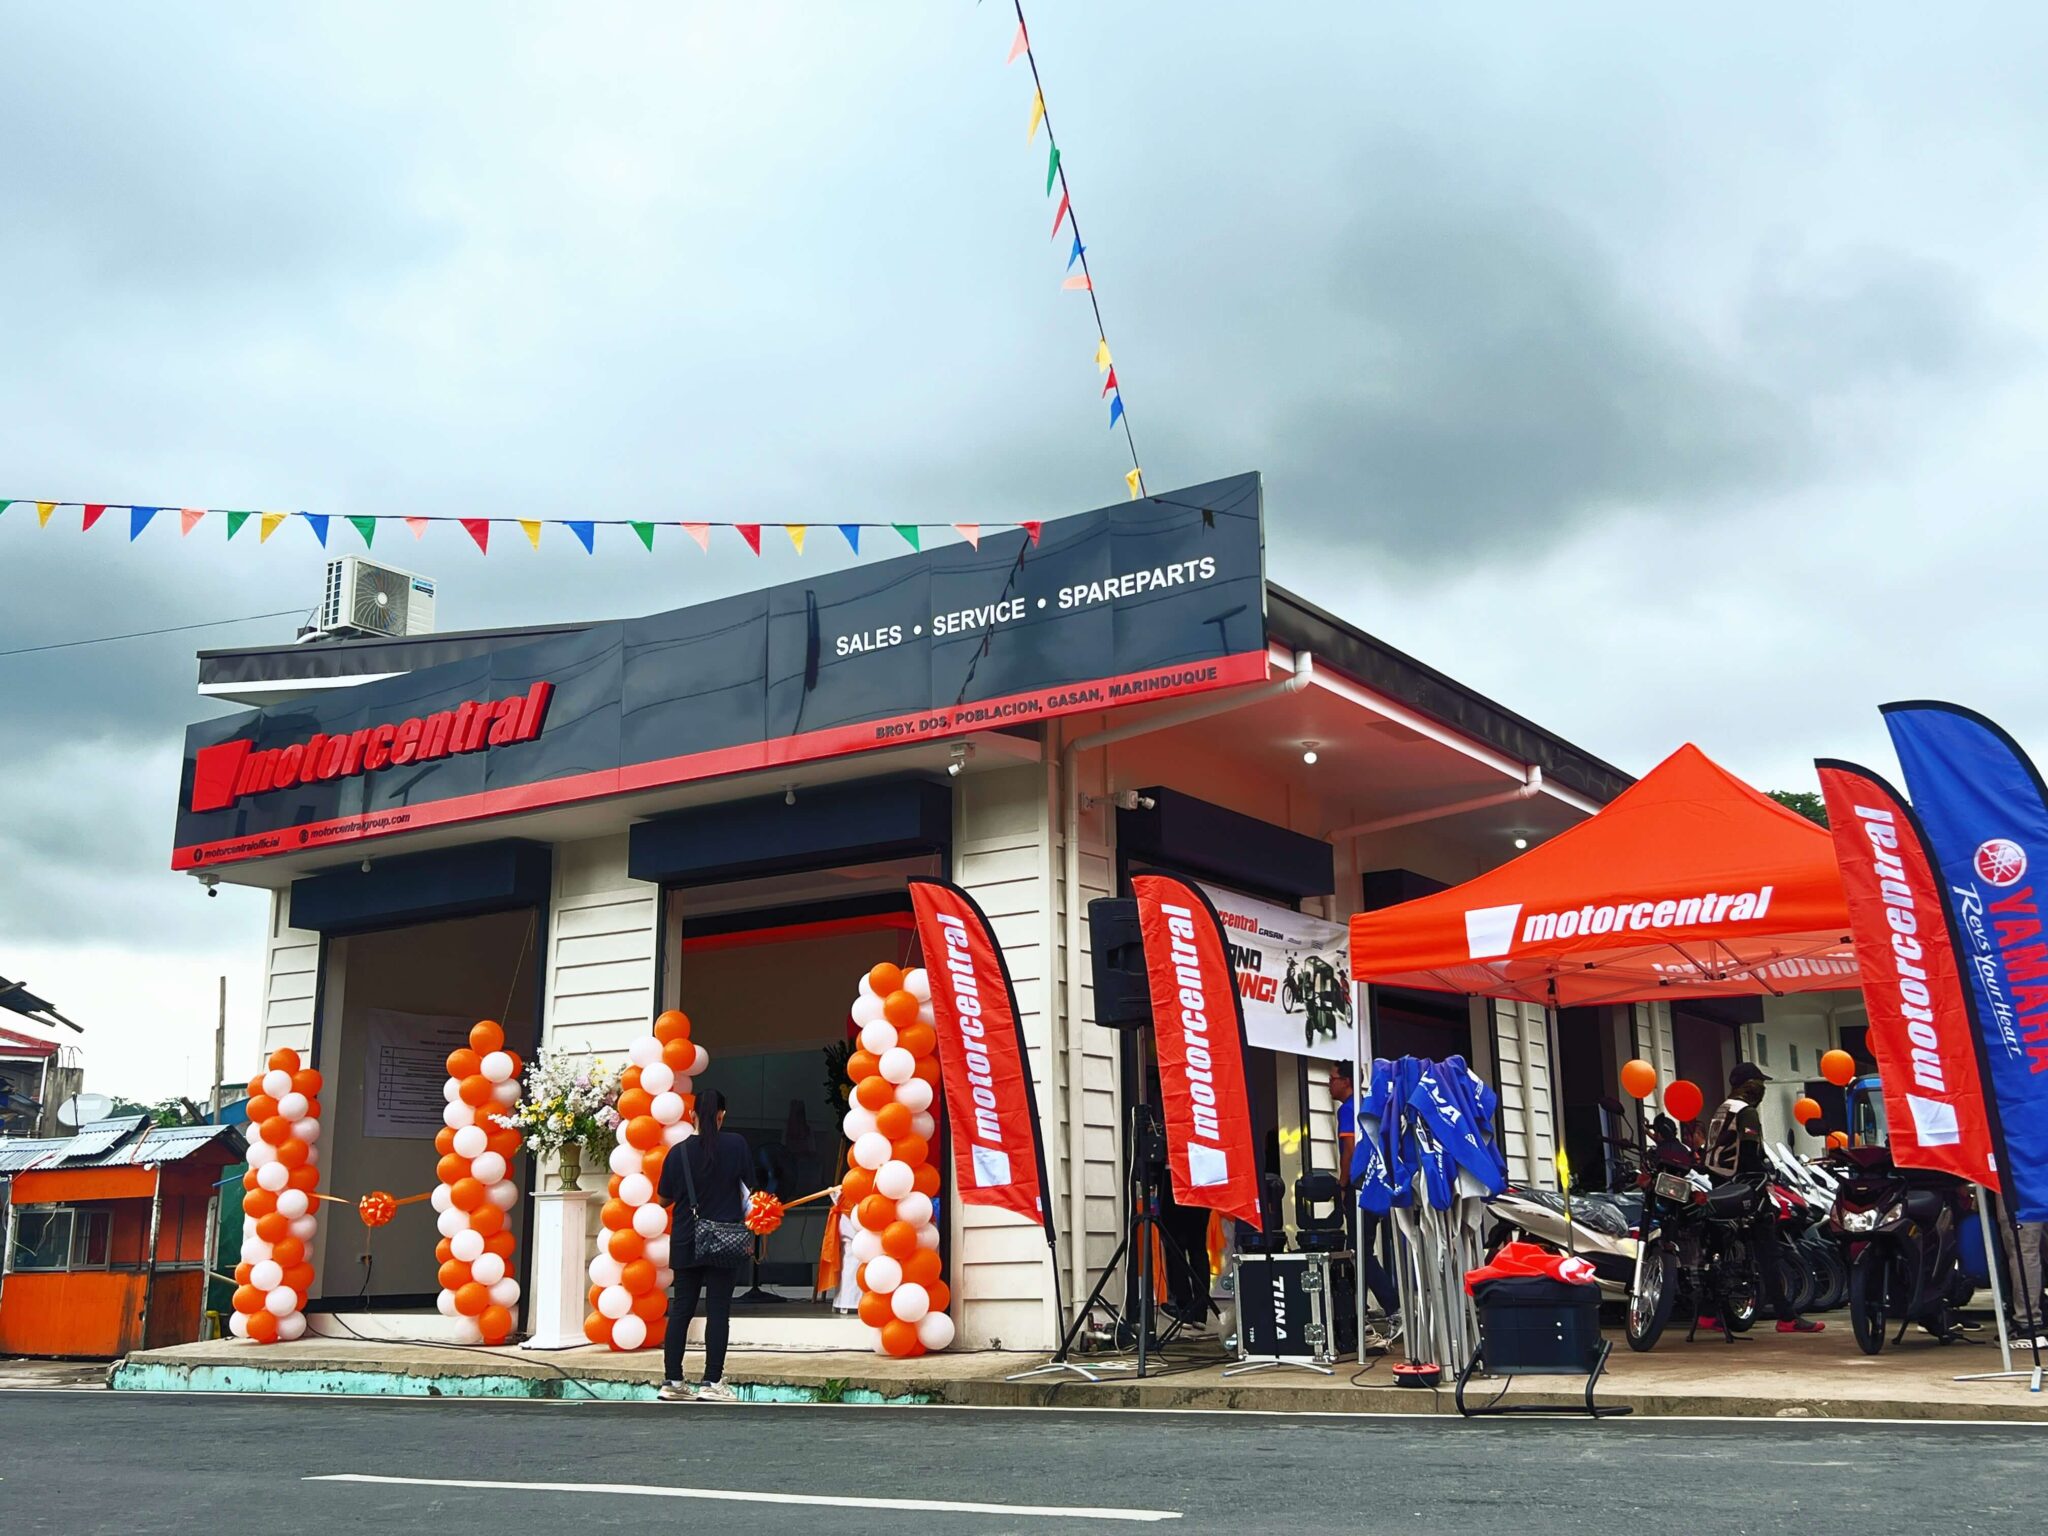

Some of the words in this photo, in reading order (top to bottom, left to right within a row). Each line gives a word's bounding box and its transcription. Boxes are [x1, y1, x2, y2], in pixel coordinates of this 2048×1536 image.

[836, 626, 902, 656] SALES
[933, 598, 1026, 637] SERVICE
[1058, 557, 1216, 610] SPAREPARTS
[235, 681, 553, 796] motorcentral
[875, 721, 916, 739] BRGY.
[919, 716, 951, 733] DOS,
[955, 699, 1043, 726] POBLACION,
[1047, 688, 1104, 709] GASAN,
[1108, 667, 1218, 698] MARINDUQUE
[1229, 943, 1262, 972] AND
[1258, 928, 1284, 941] GASAN
[1521, 886, 1774, 943] motorcentral
[1854, 804, 1945, 1093] motorcentral
[1161, 904, 1221, 1141] motorcentral
[1952, 882, 1993, 951] Revs
[1974, 953, 2005, 1003] Your
[1993, 1002, 2022, 1057] Heart
[937, 912, 1003, 1143] motorcentral
